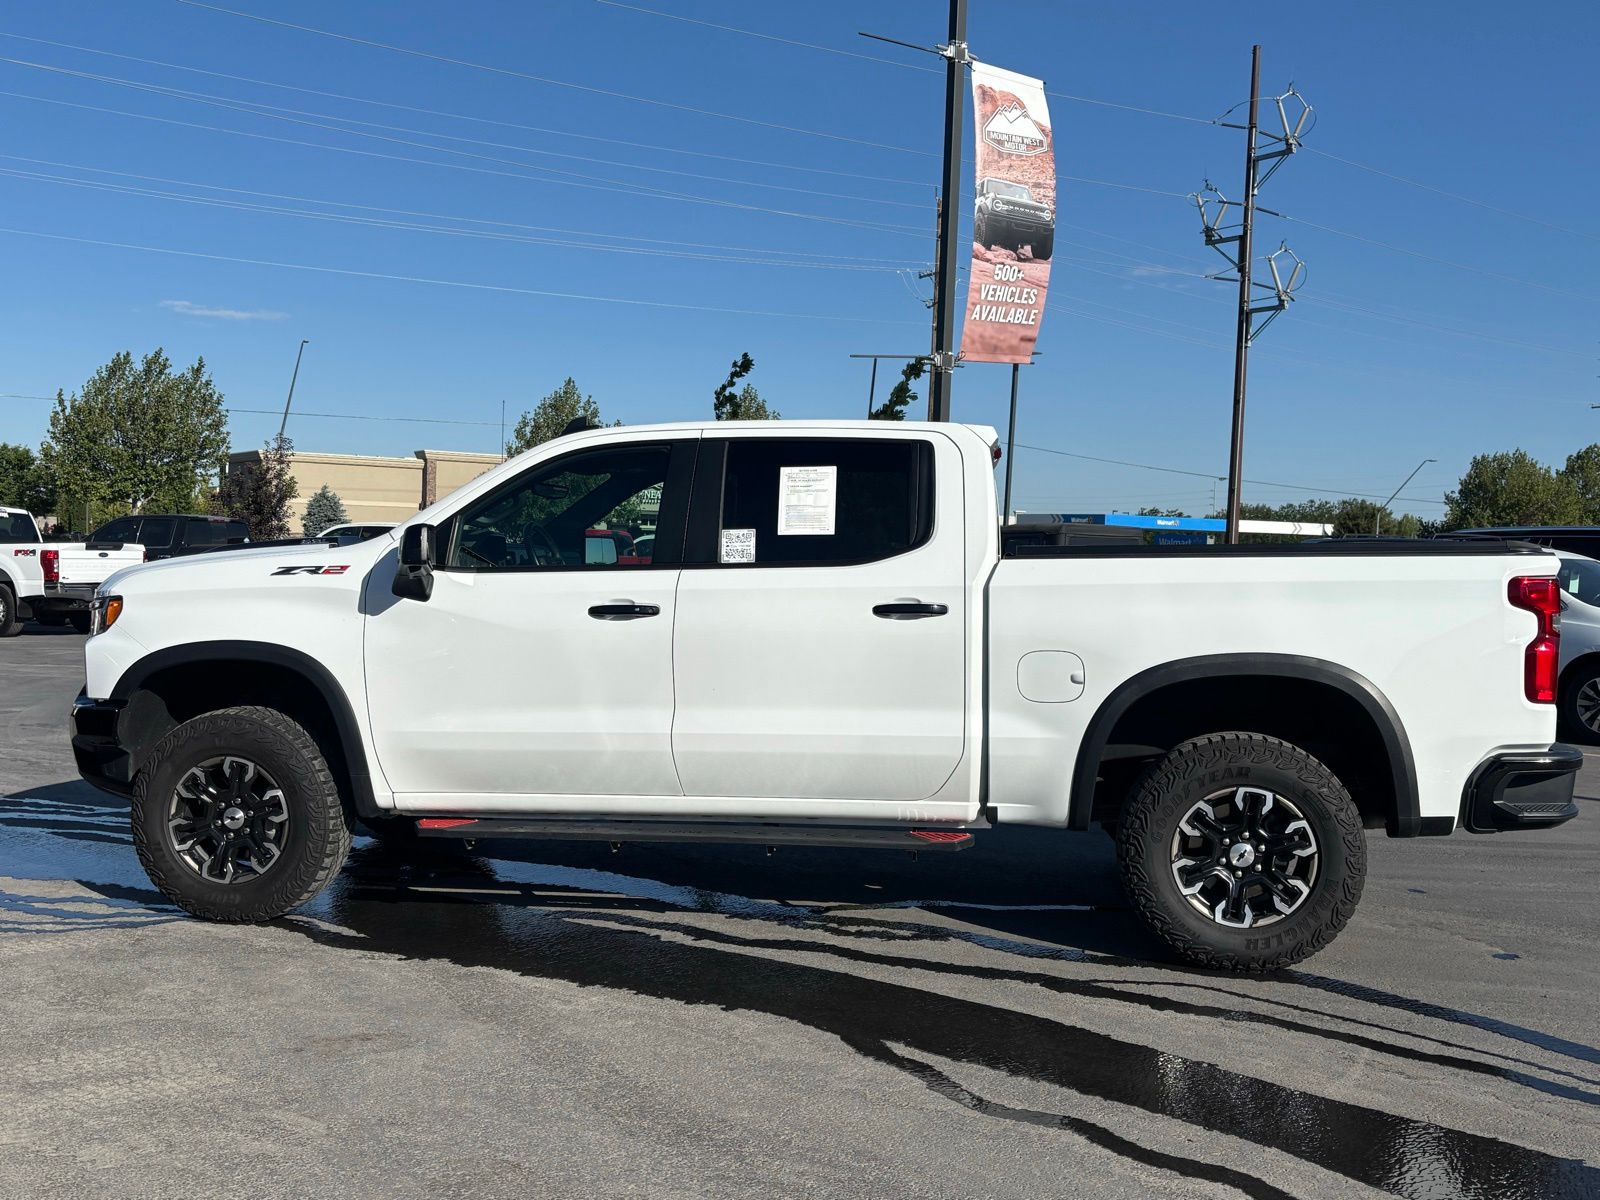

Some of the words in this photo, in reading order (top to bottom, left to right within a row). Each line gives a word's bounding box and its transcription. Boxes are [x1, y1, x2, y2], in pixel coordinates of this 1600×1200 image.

[991, 131, 1023, 145] MOUNTAIN
[1023, 137, 1040, 147] WEST
[993, 263, 1025, 281] 500+
[980, 283, 1038, 305] VEHICLES
[970, 304, 1039, 325] AVAILABLE
[1158, 537, 1192, 545] Walmart
[14, 549, 36, 557] FX4
[270, 565, 351, 576] ZR2
